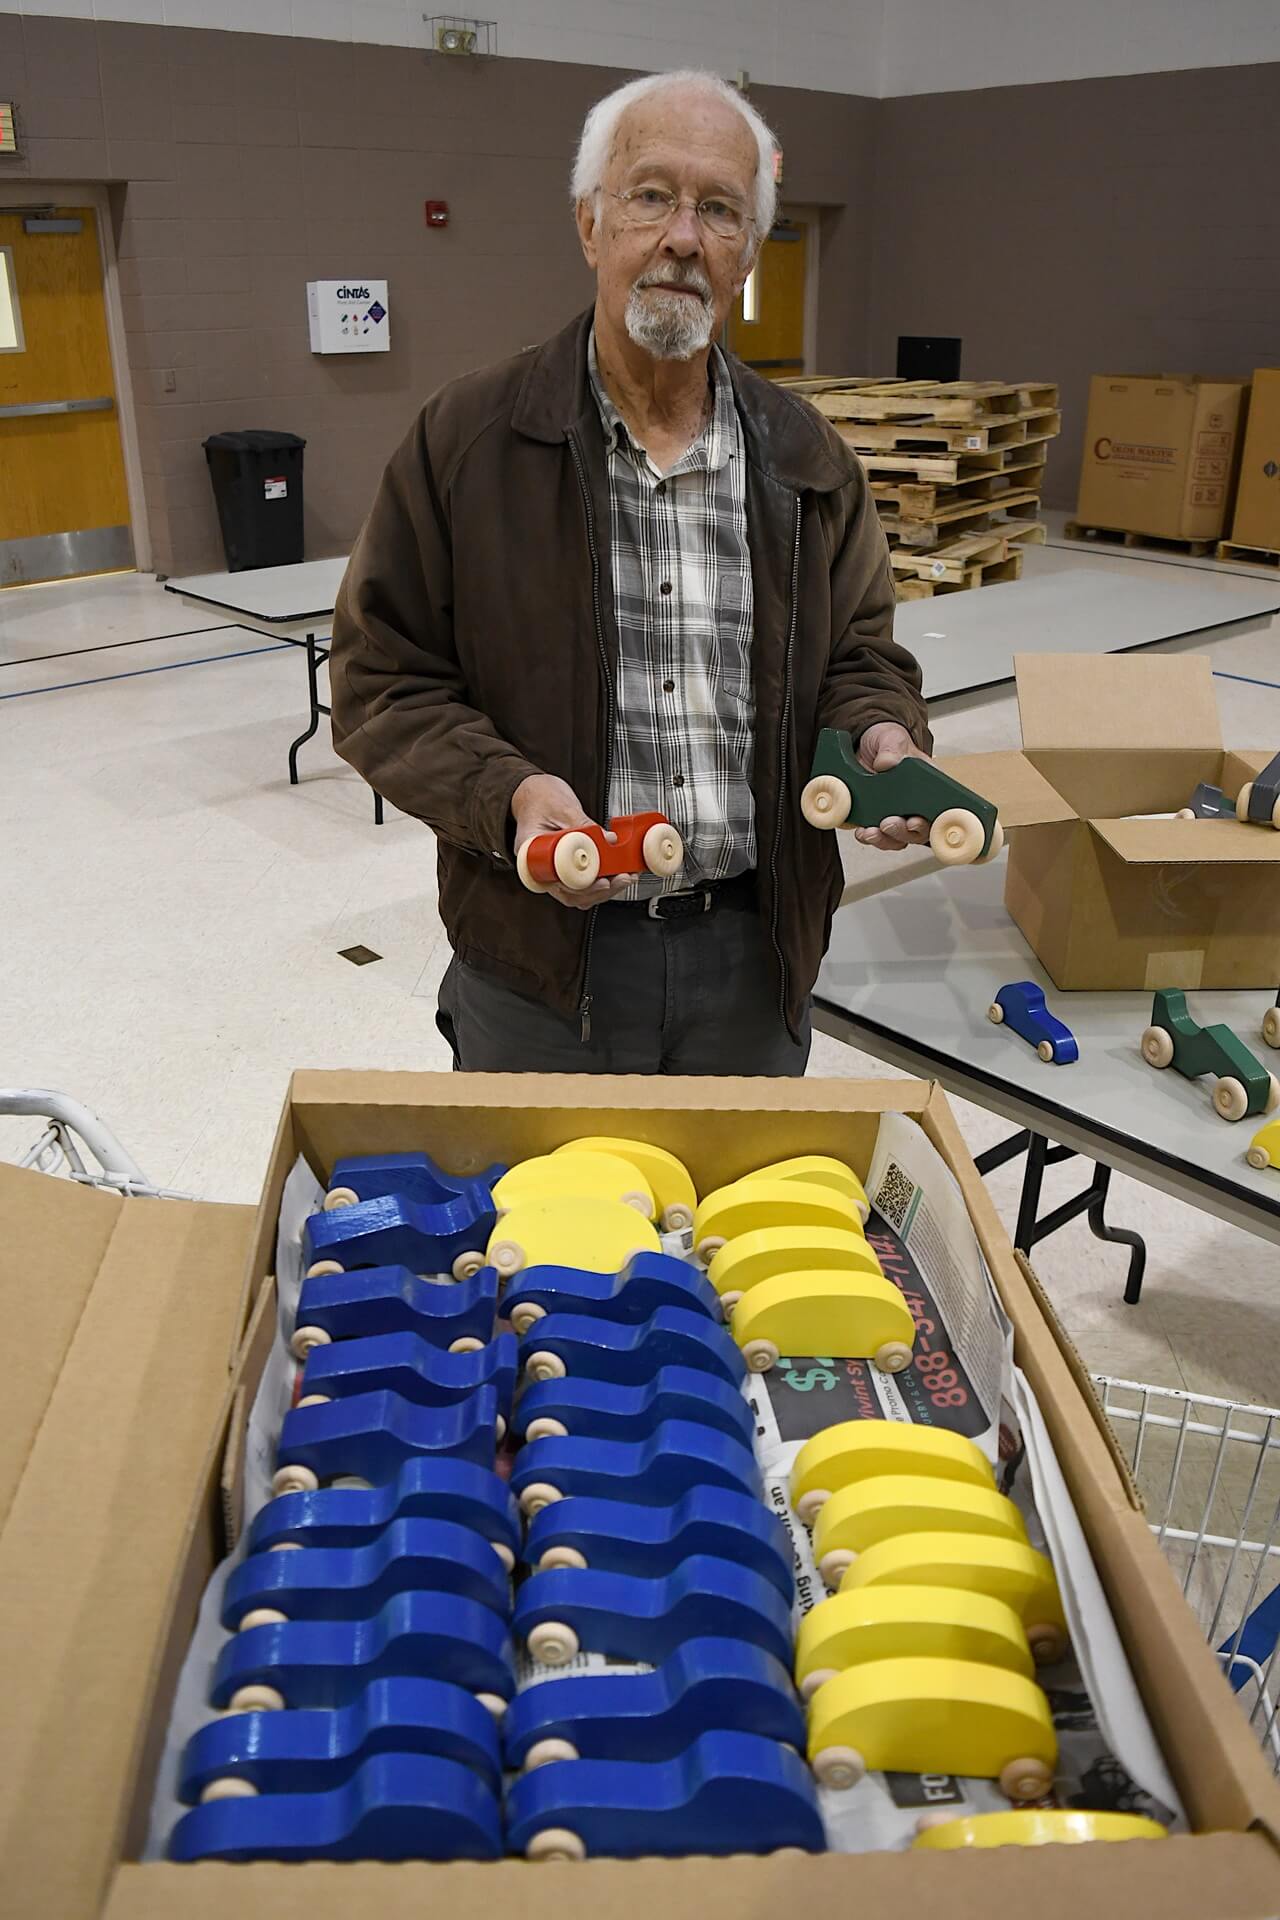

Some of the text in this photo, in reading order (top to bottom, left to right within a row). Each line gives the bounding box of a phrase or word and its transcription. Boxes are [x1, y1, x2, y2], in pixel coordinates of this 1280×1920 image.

[902, 1369, 916, 1388] CAL
[883, 1385, 902, 1416] Promo
[913, 1400, 933, 1425] URRY
[770, 1486, 785, 1506] an
[796, 1575, 815, 1617] king
[920, 1773, 956, 1801] FO
